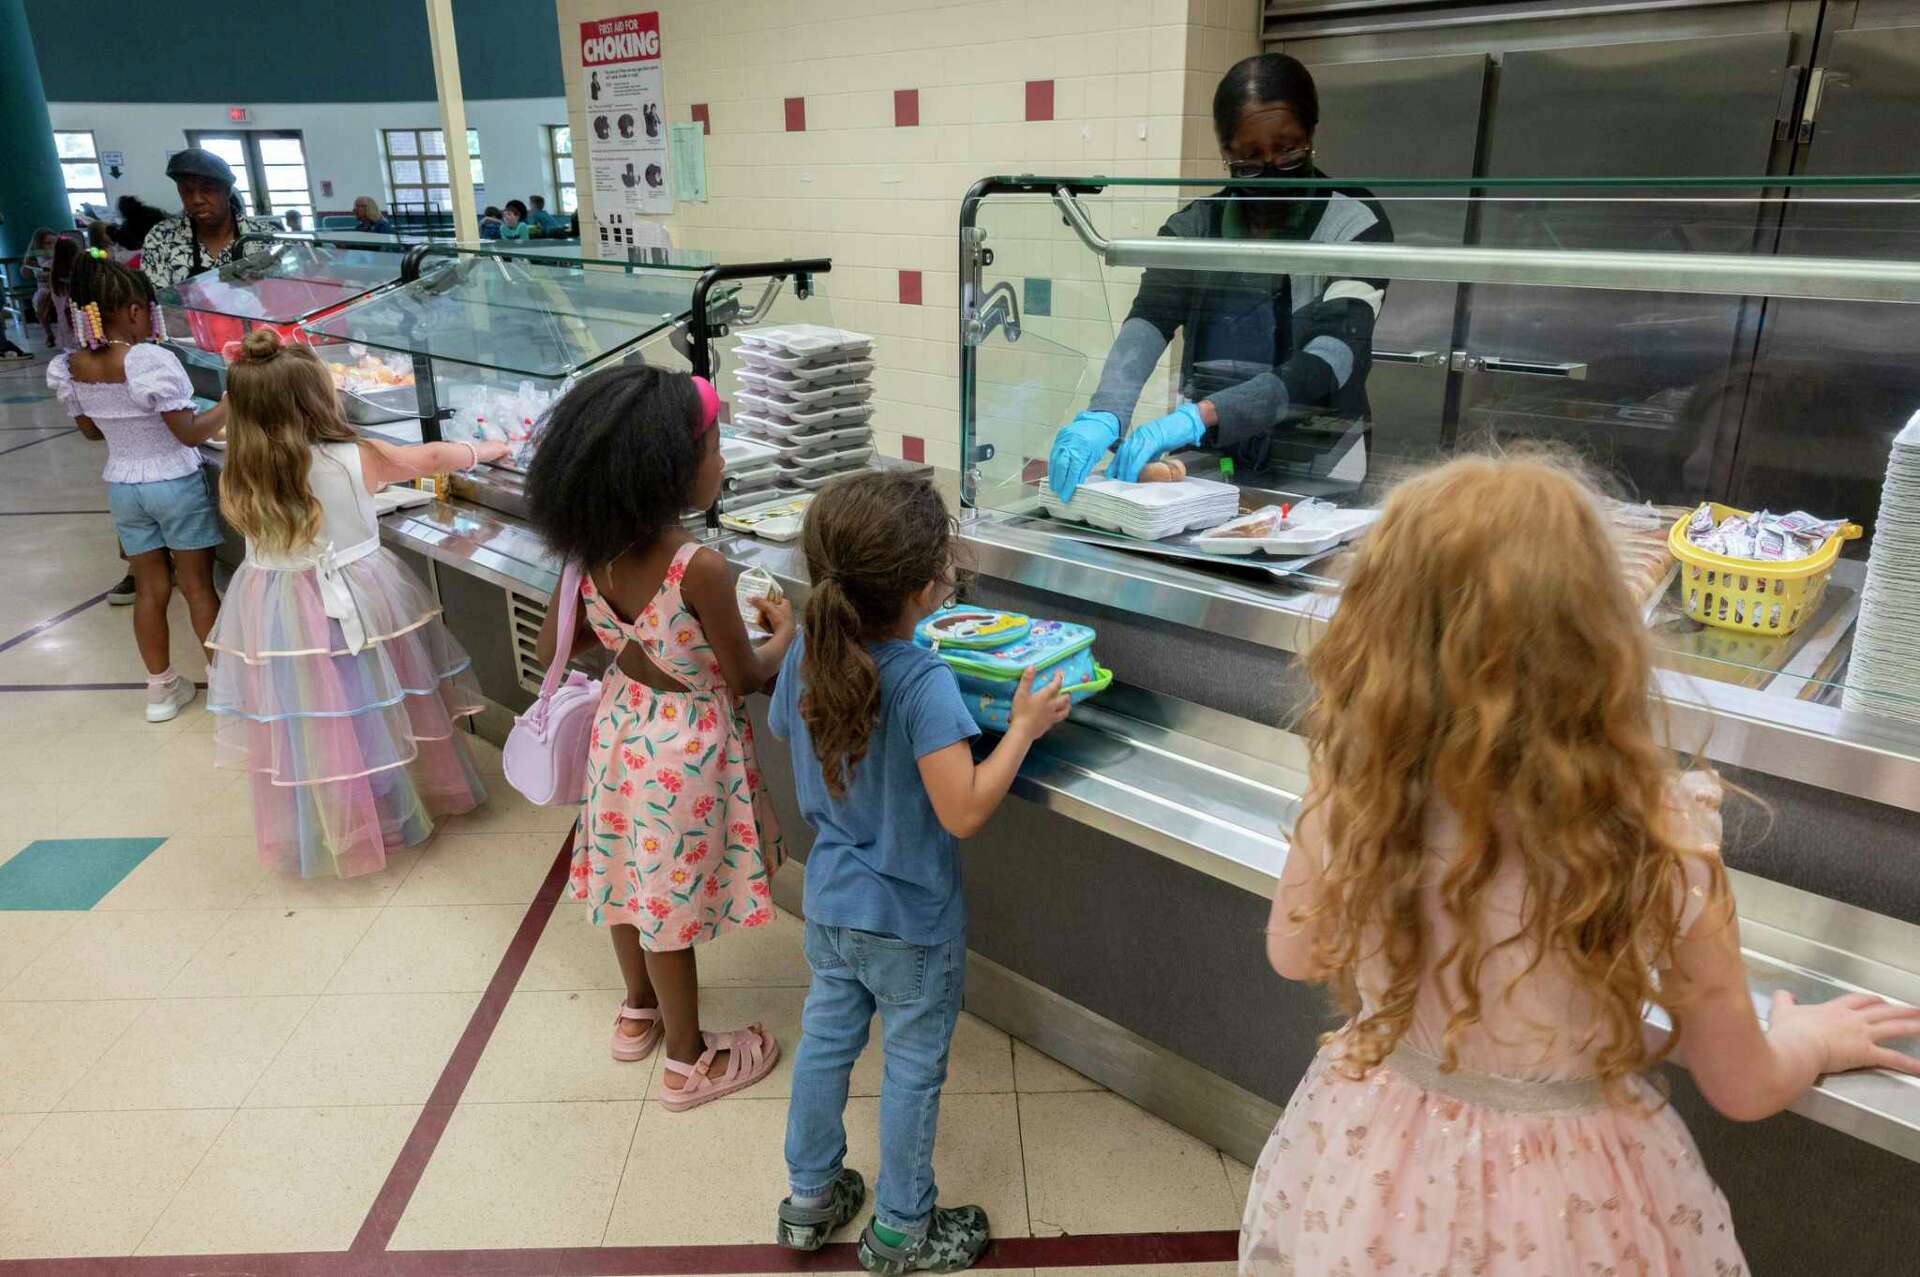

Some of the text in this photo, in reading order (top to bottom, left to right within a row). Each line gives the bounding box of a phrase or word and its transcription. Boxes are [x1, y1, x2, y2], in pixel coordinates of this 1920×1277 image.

[599, 18, 638, 35] FIRST AID FOR
[583, 30, 659, 62] CHOKING
